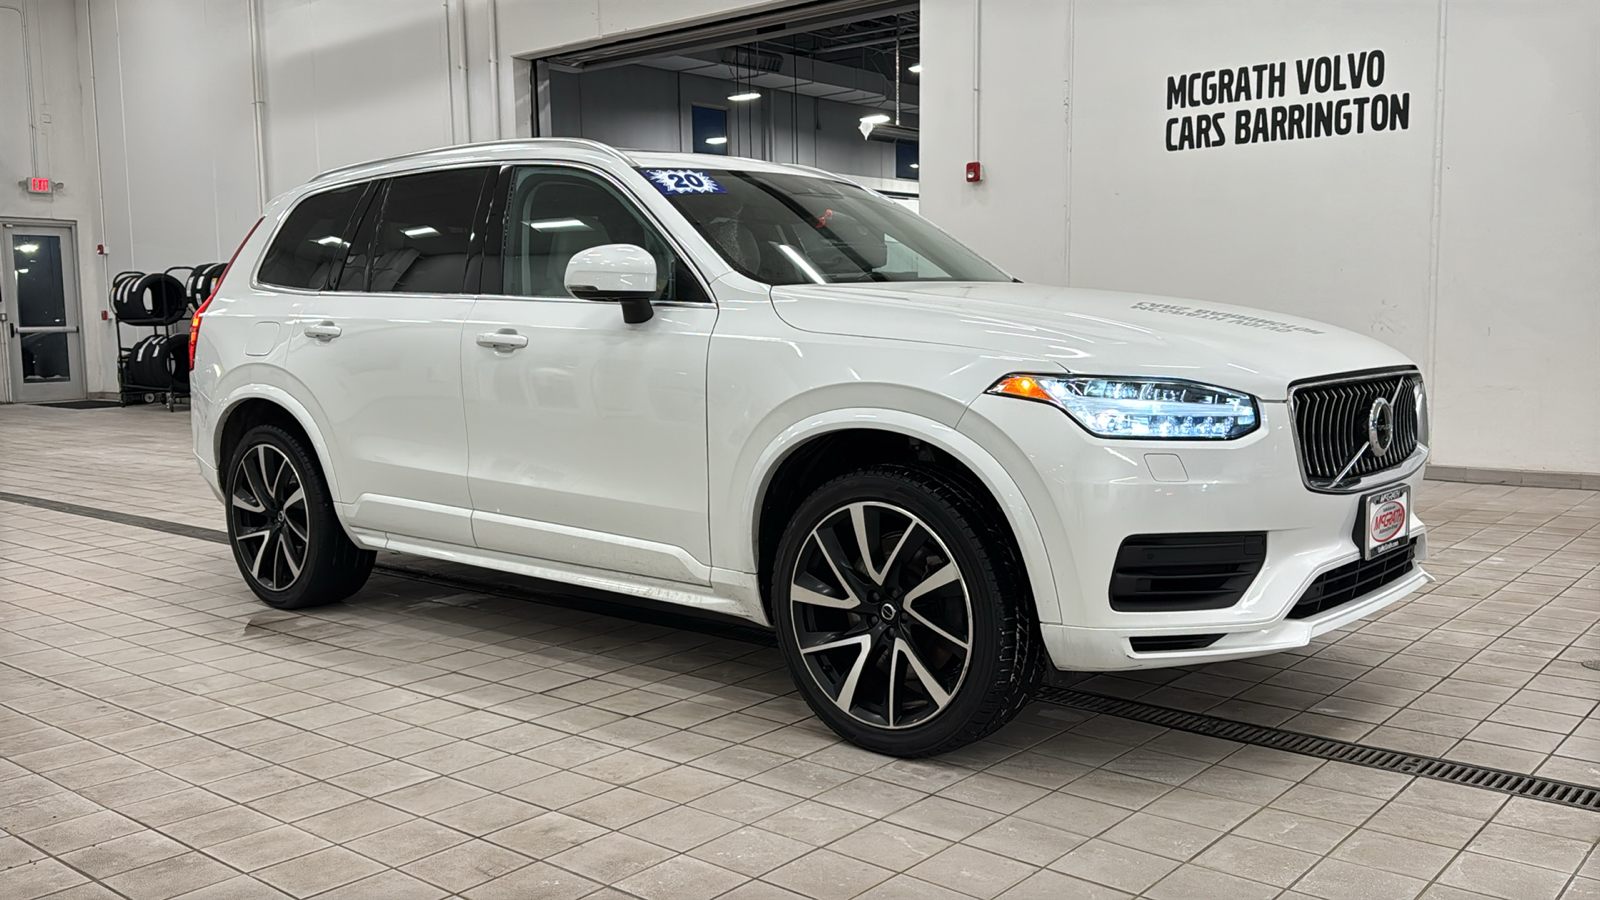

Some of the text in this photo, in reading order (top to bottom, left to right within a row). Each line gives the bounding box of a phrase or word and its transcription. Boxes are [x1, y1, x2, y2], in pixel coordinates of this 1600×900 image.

[1166, 49, 1385, 111] MCGRATH VOLVO
[1165, 93, 1410, 152] CARS BARRINGTON
[31, 177, 49, 192] EXIT
[667, 173, 704, 188] 20
